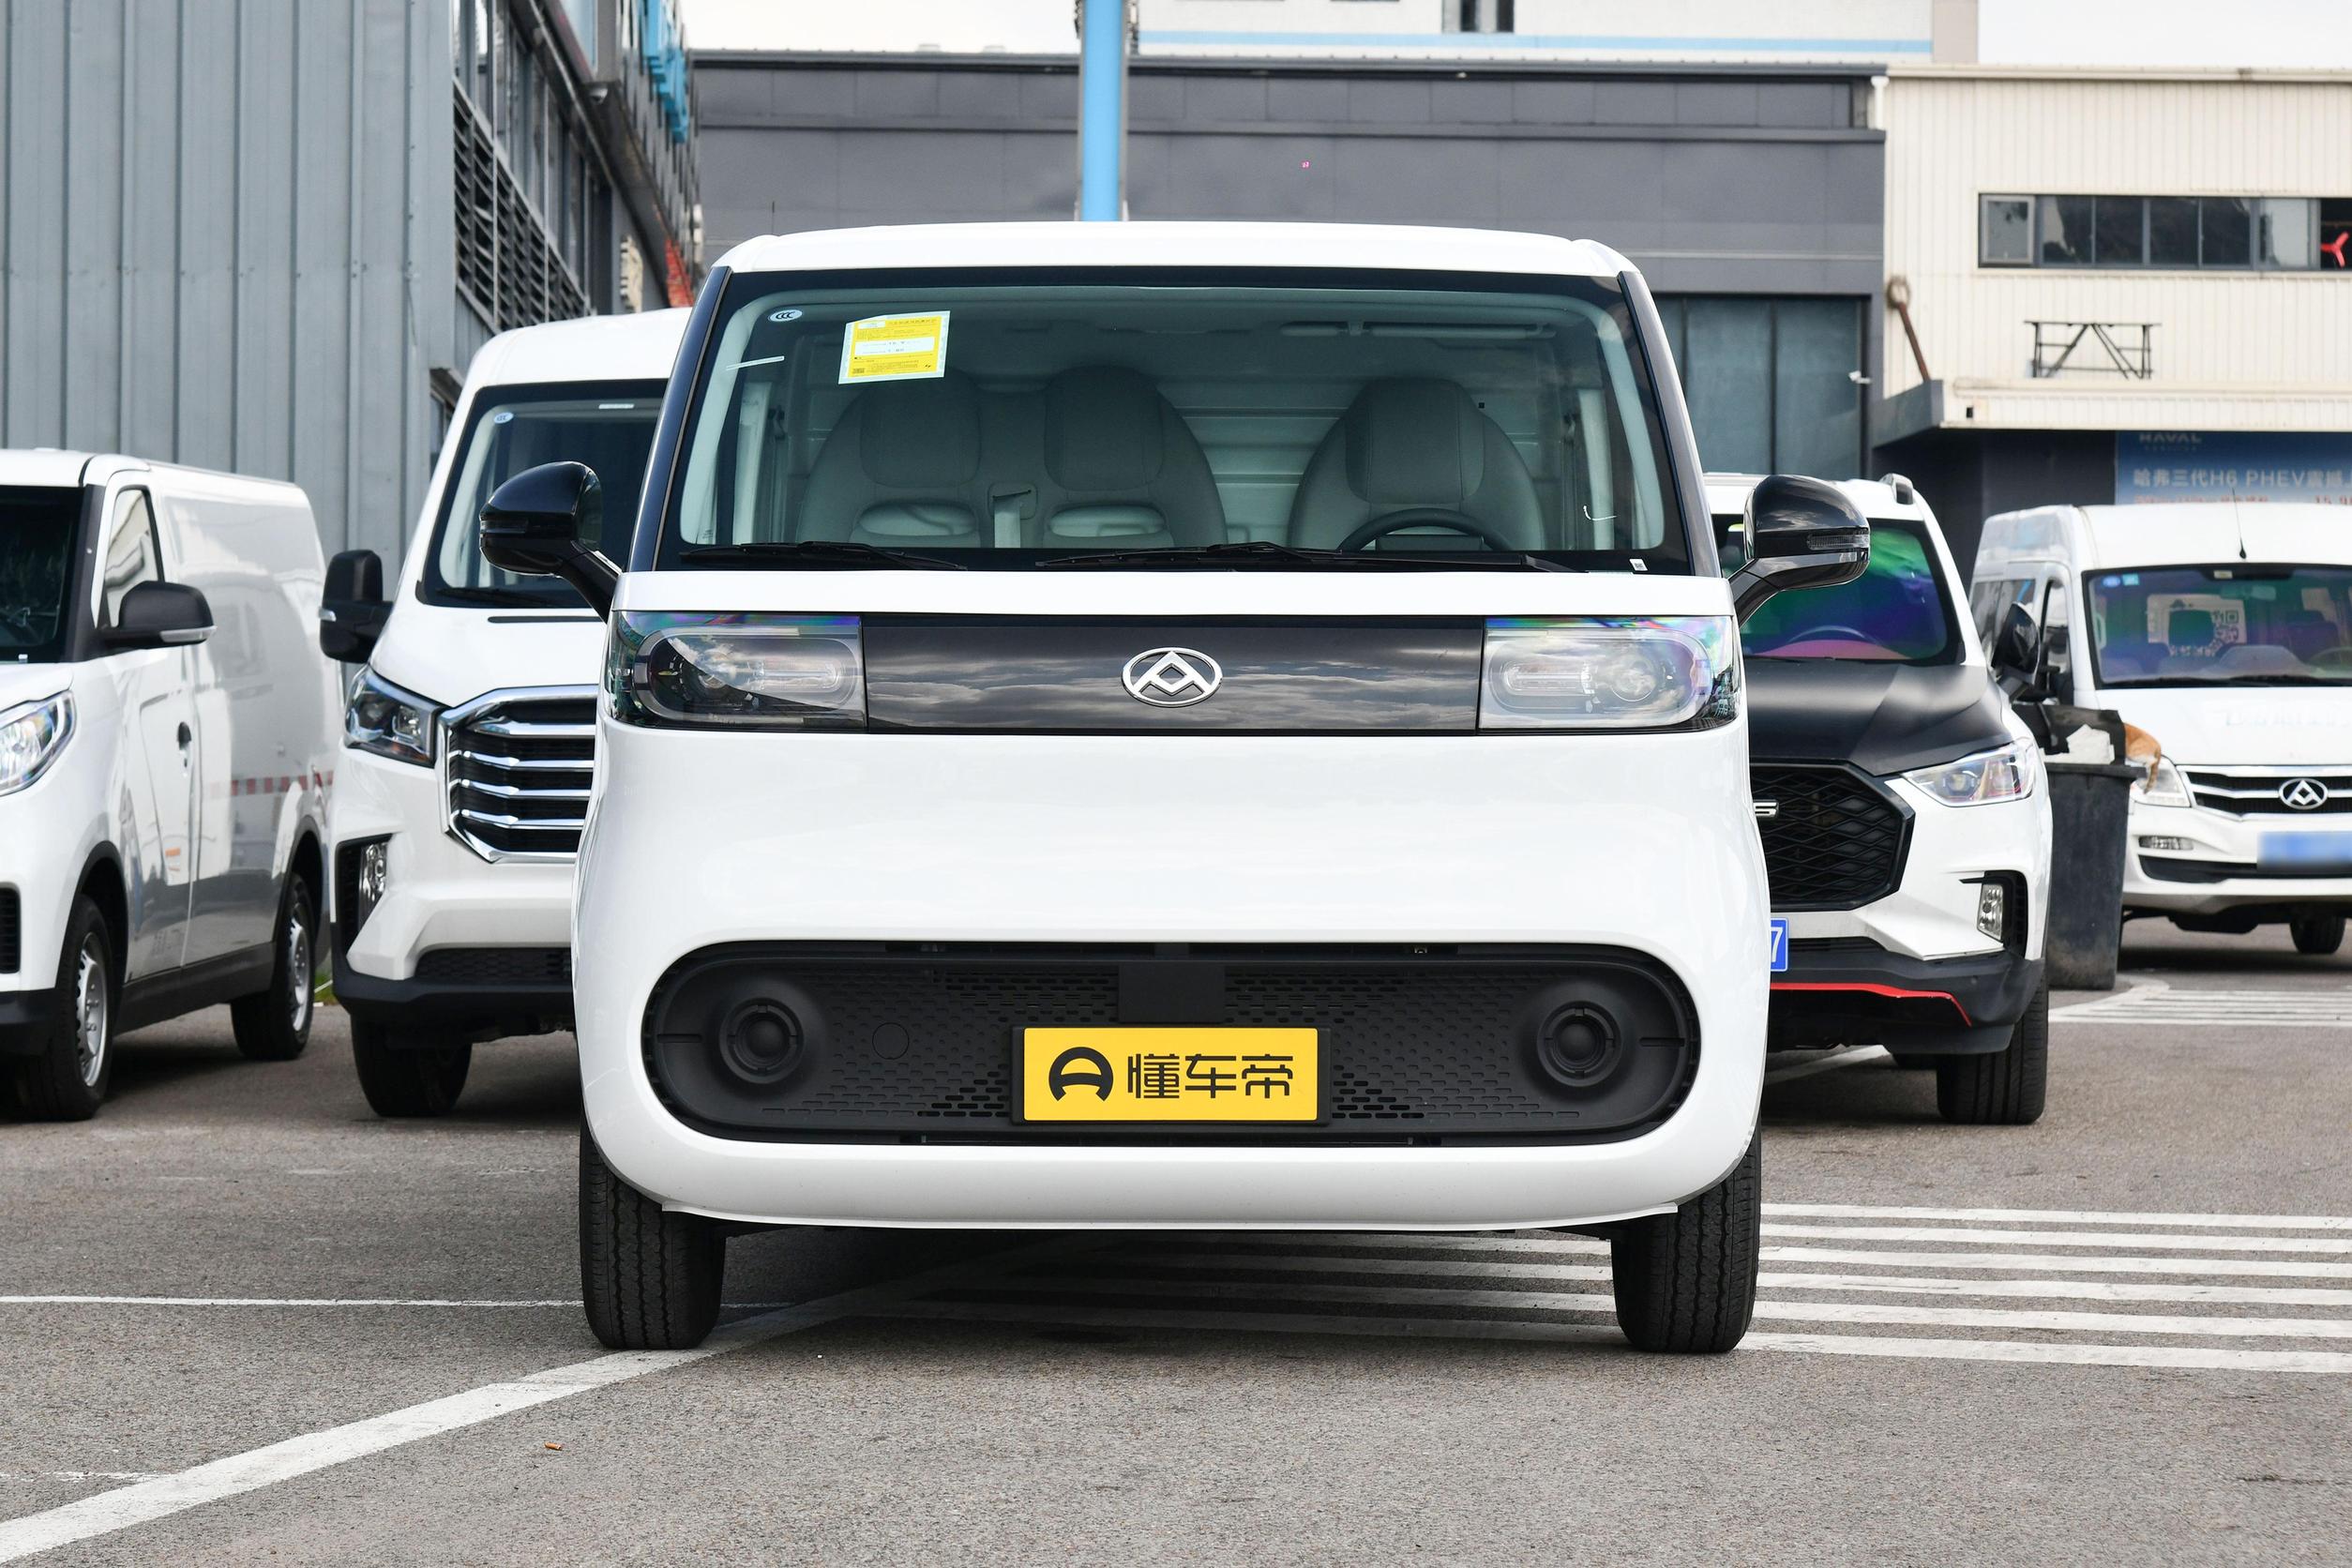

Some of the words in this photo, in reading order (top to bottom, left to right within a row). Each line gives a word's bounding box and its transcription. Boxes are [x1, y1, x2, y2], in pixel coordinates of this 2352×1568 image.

[2139, 433, 2202, 444] HAVAL
[1127, 1053, 1294, 1099] 懂车帝
